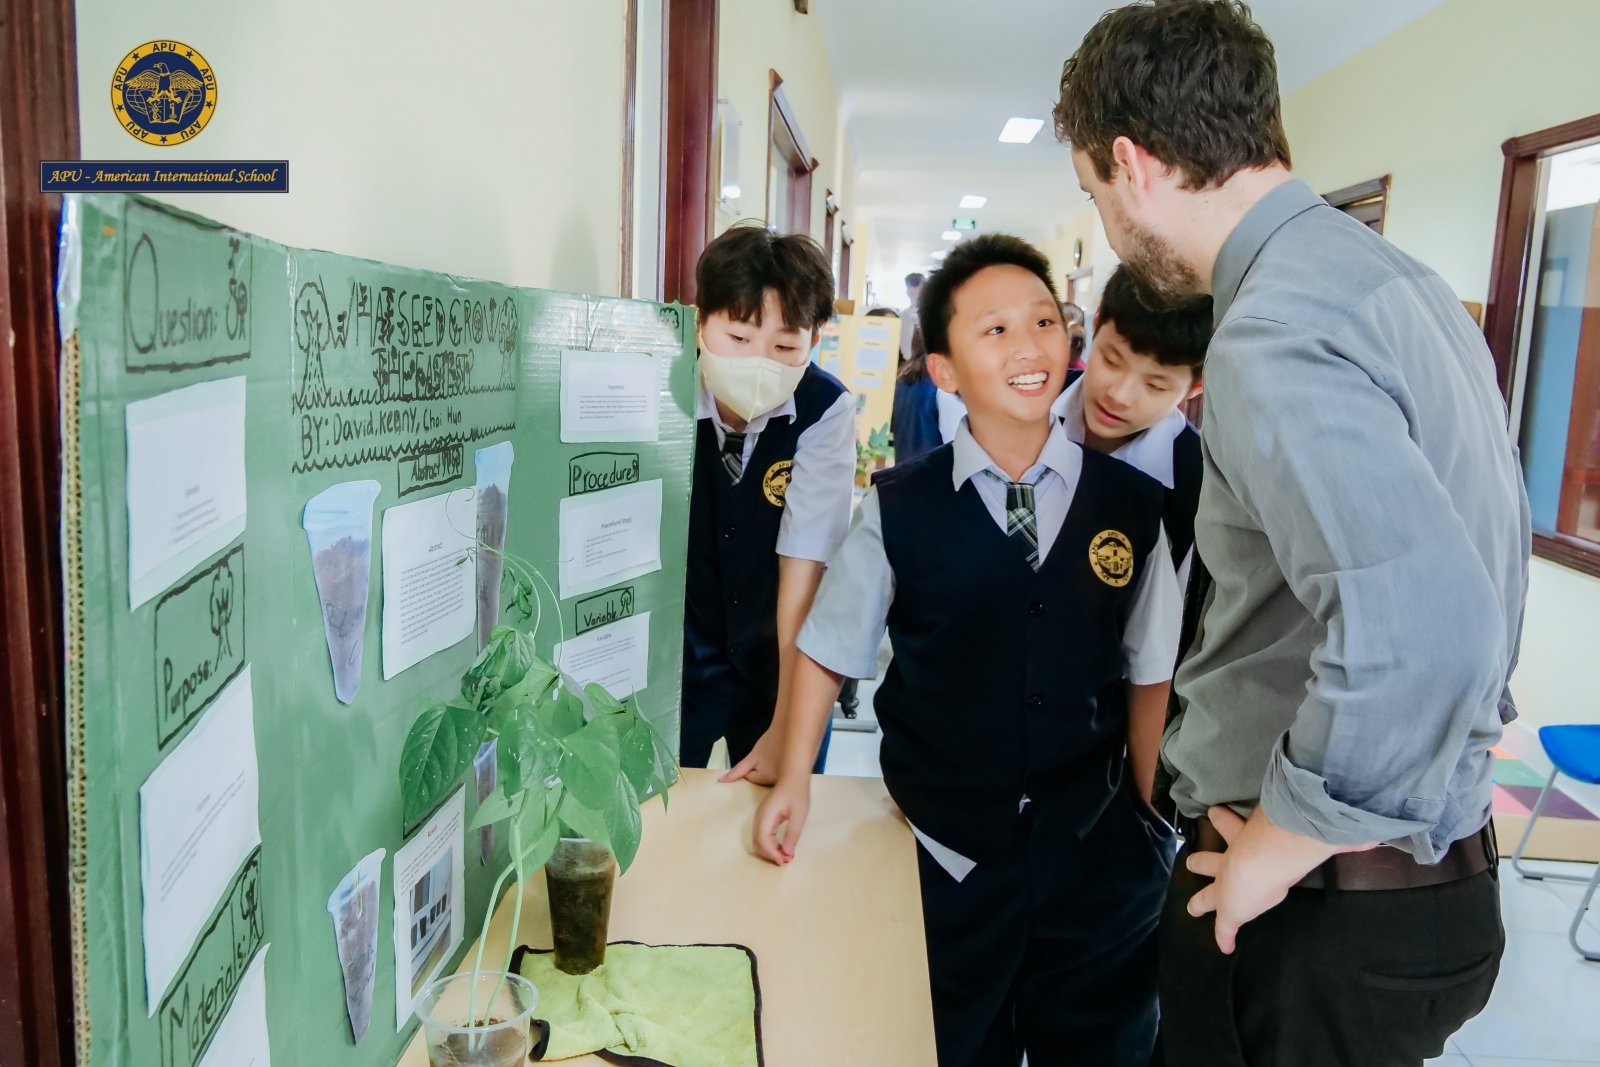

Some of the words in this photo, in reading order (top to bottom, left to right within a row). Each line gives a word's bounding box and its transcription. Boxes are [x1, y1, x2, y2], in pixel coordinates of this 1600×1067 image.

[128, 232, 218, 354] Question:
[397, 290, 445, 347] SEED
[301, 414, 329, 459] BY:
[423, 409, 442, 431] Choi
[447, 406, 462, 425] Hun
